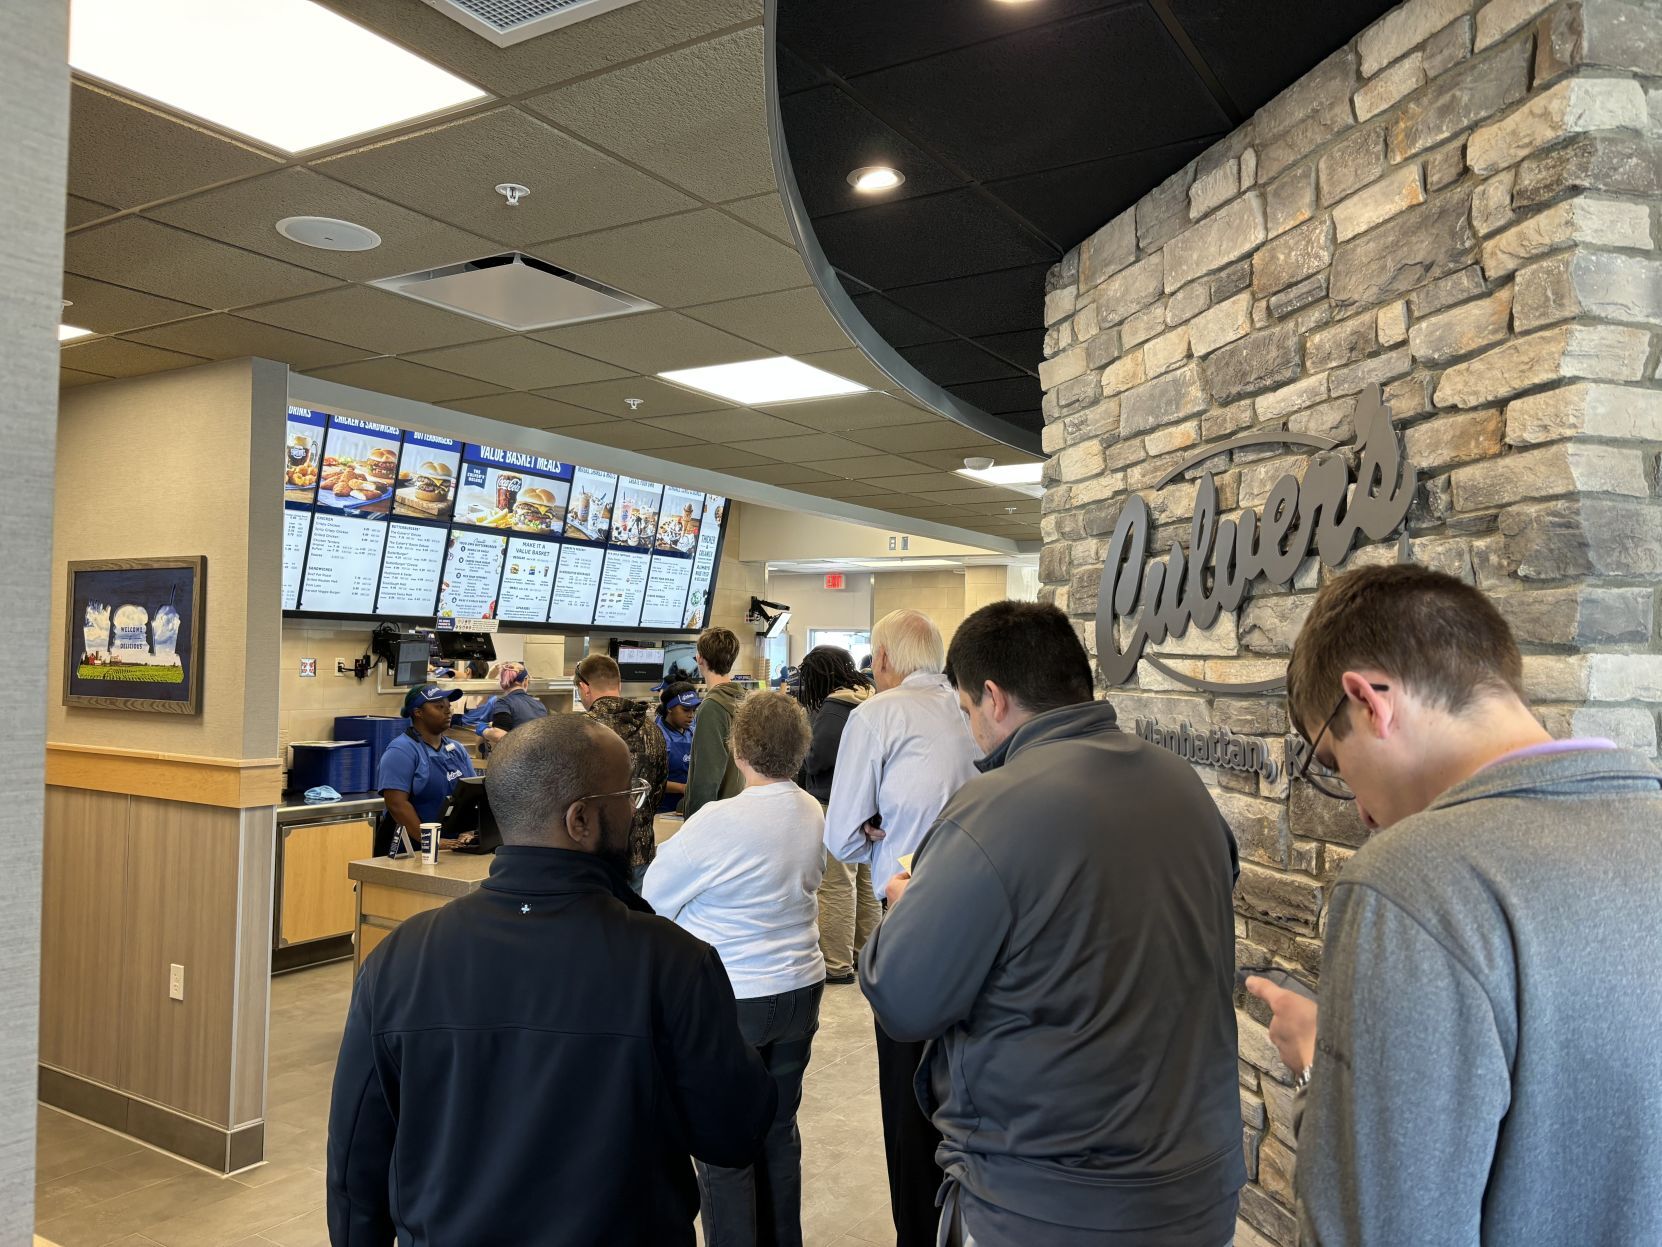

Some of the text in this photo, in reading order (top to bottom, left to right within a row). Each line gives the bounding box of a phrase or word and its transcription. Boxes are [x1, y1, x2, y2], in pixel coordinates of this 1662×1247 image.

[480, 445, 504, 462] VALUE
[506, 450, 535, 468] BASKET
[537, 457, 561, 473] MEALS
[1096, 382, 1417, 685] Culver's
[1135, 716, 1273, 781] Manhattan,
